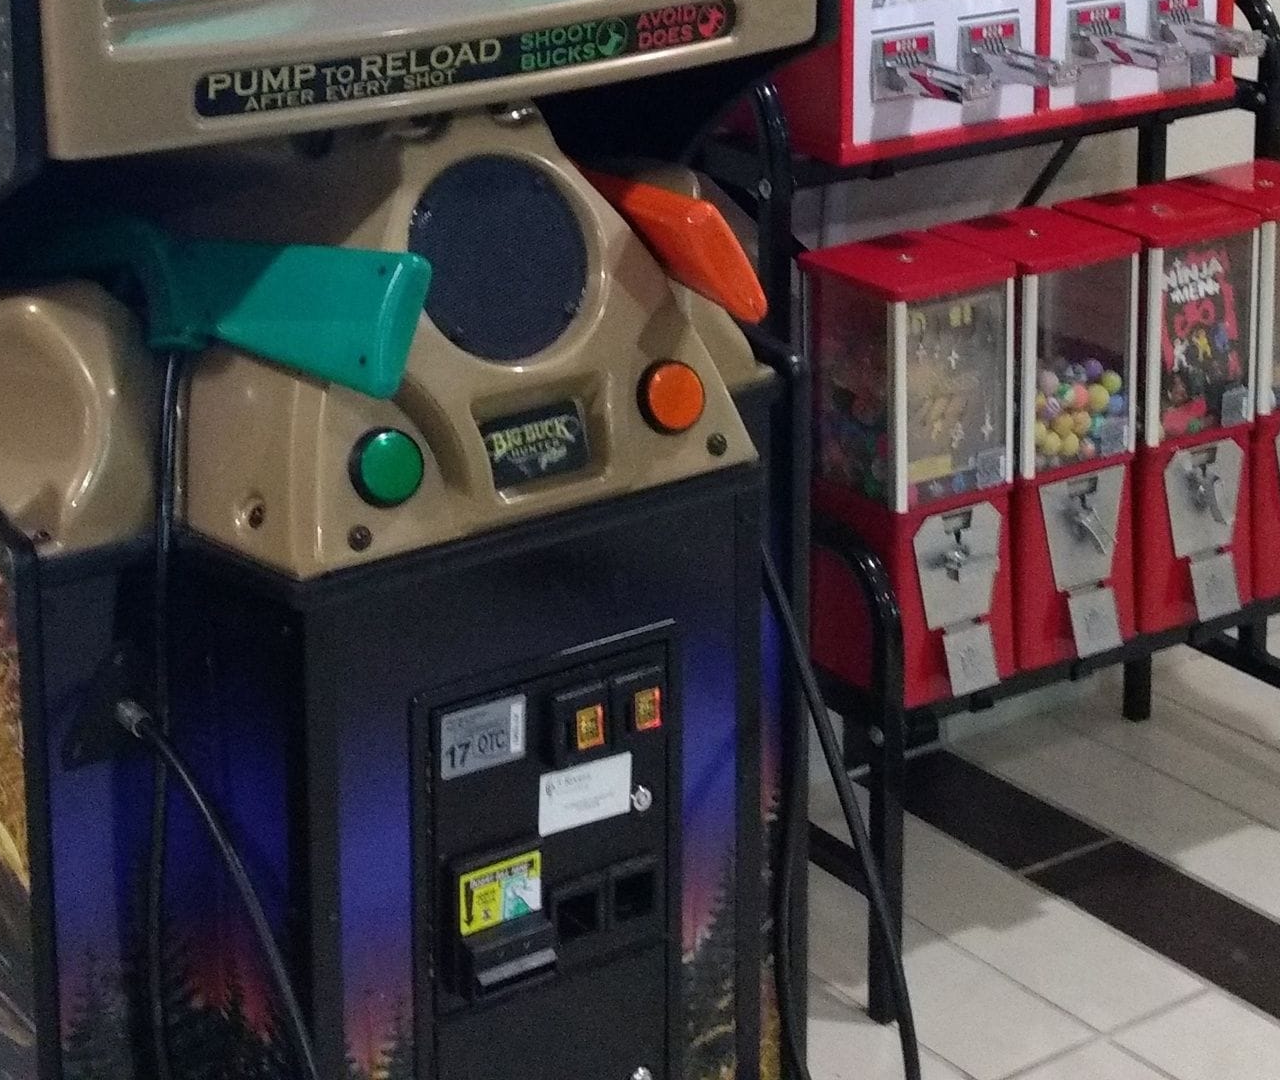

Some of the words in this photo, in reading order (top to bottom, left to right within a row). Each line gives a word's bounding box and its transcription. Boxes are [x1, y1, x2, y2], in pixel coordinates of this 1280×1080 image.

[636, 3, 697, 30] AVOID
[520, 22, 597, 51] SHOOT
[638, 24, 694, 49] DOES
[207, 63, 316, 100] PUMP
[320, 64, 355, 86] TO
[360, 39, 502, 82] RELOAD
[521, 42, 596, 70] BUCKS
[244, 88, 314, 111] AFTER
[326, 79, 391, 102] EVERY
[403, 68, 457, 90] SHOT
[1161, 257, 1224, 292] NINJA
[445, 741, 472, 769] 17
